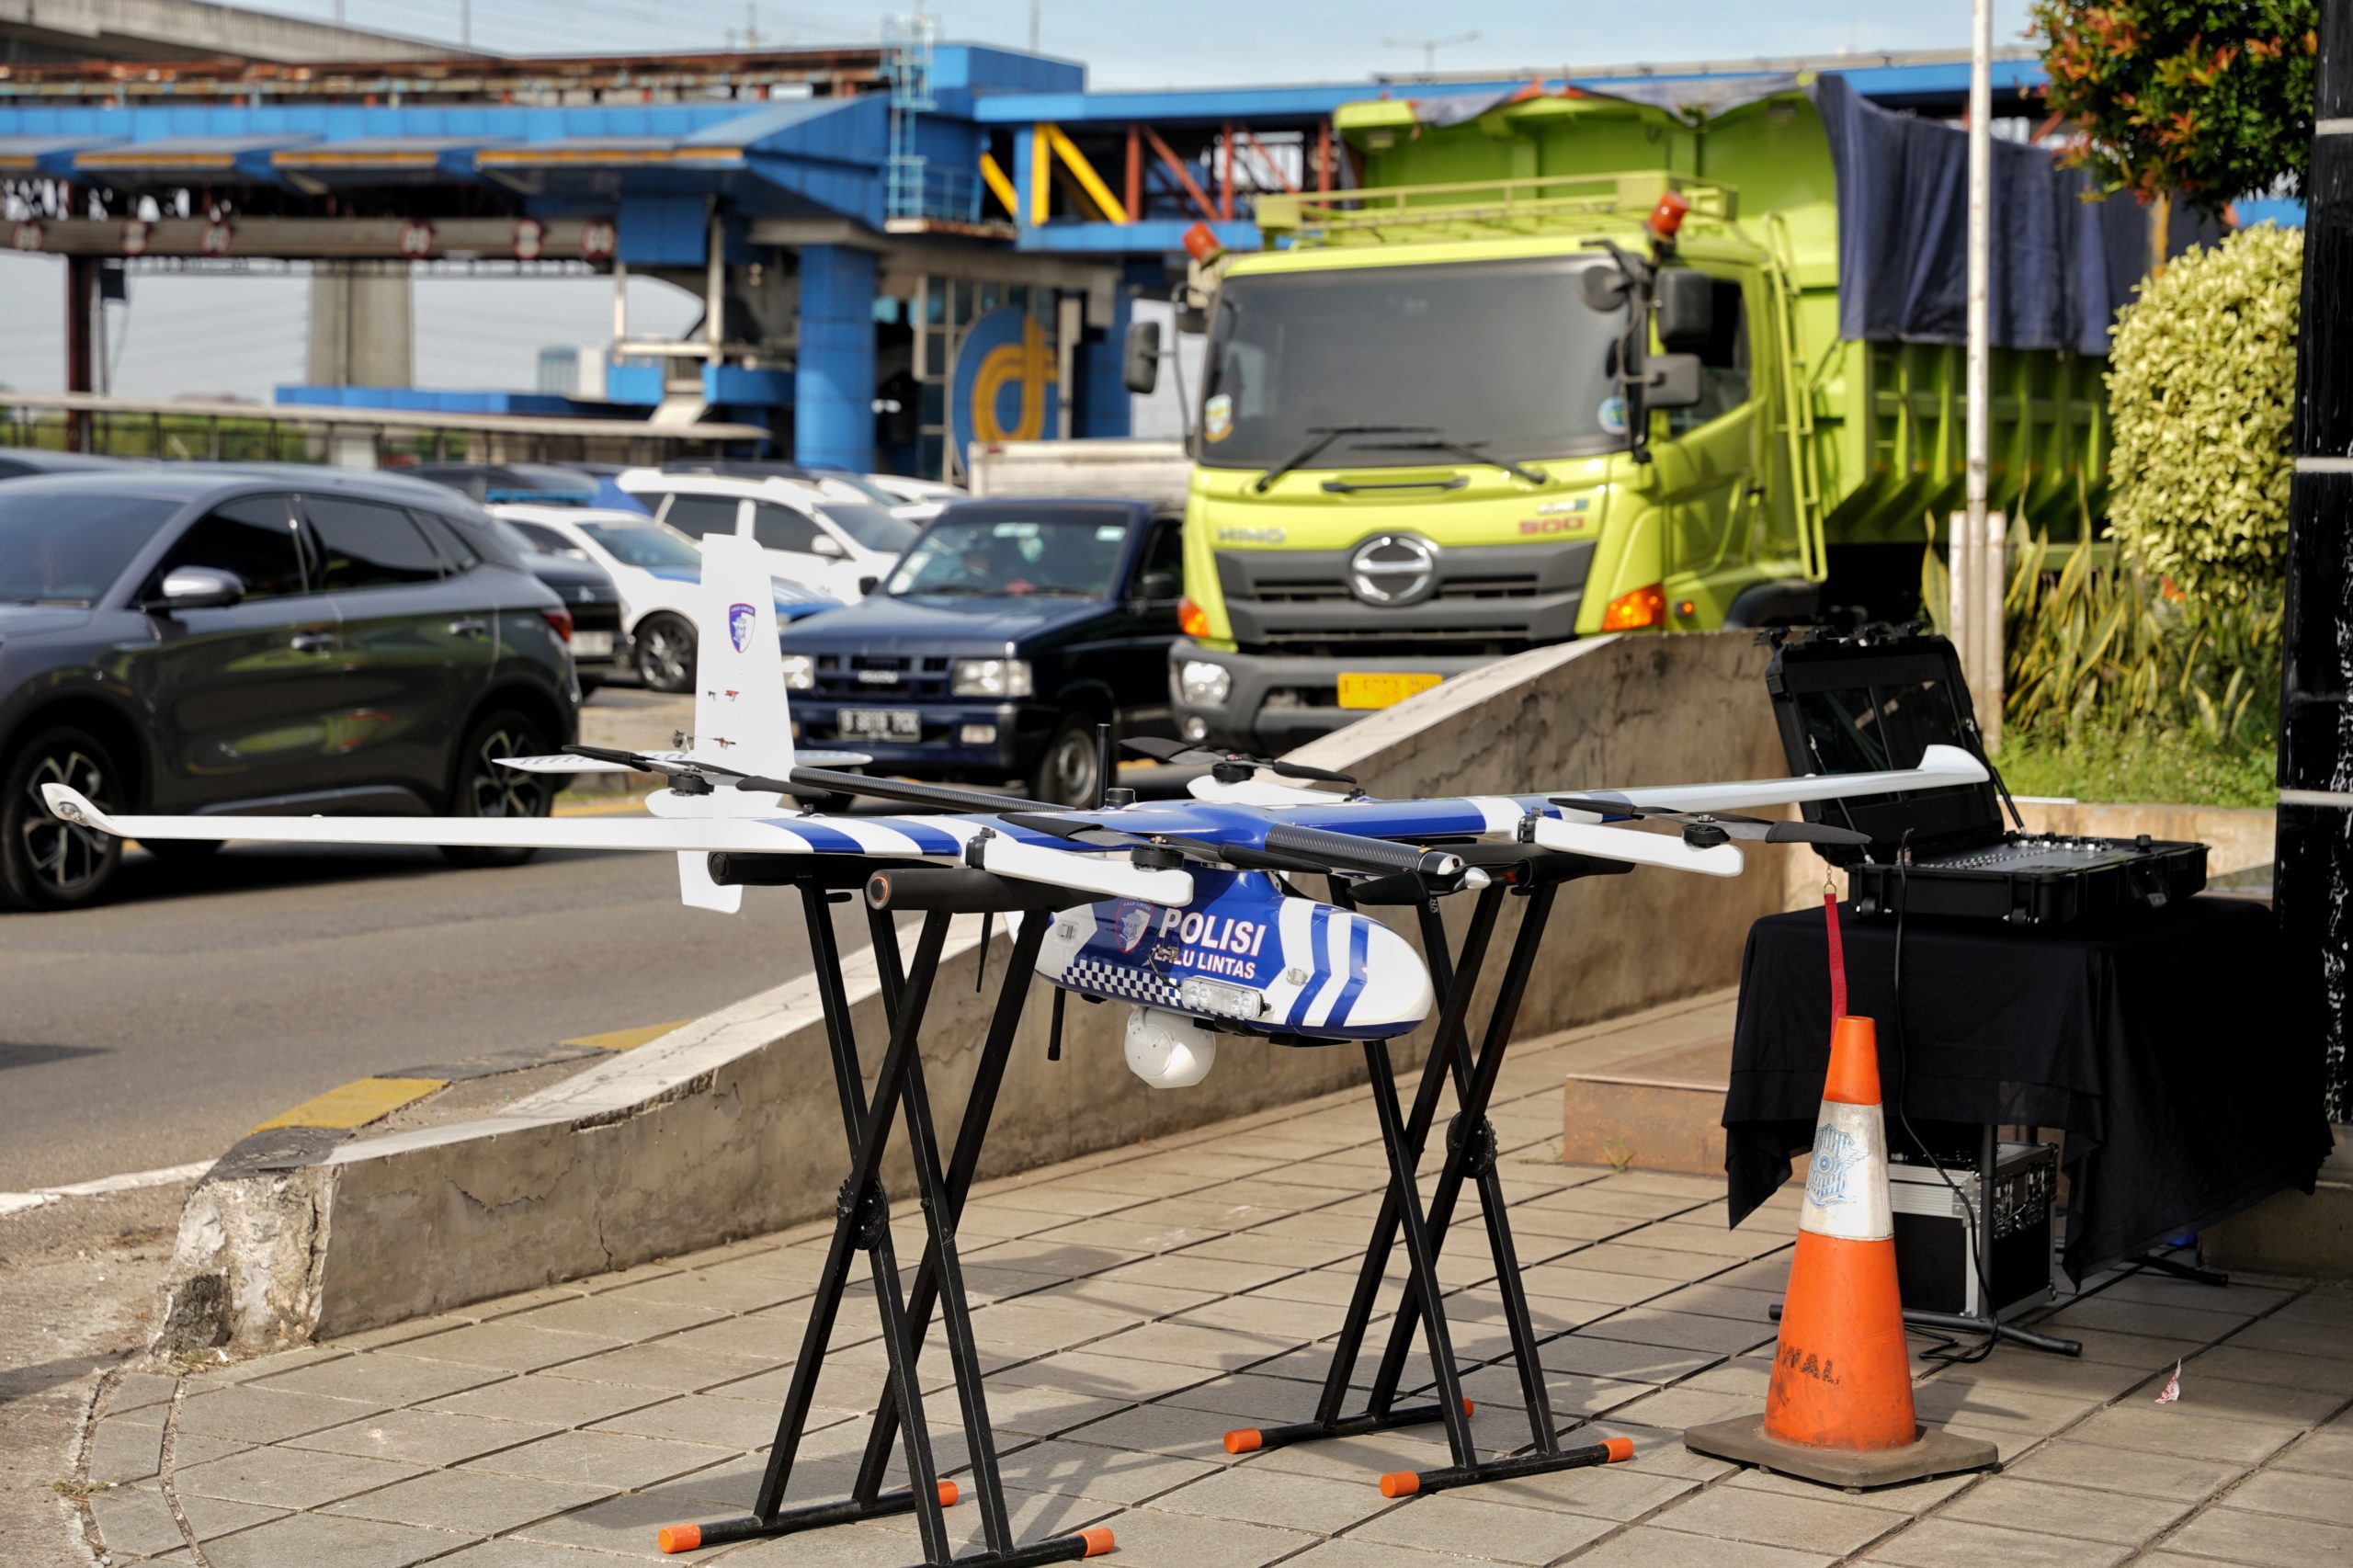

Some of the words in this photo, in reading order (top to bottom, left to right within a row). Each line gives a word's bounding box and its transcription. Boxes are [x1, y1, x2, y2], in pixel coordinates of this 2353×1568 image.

[1518, 516, 1585, 536] 500
[1158, 907, 1267, 957] POLISI
[1197, 952, 1256, 980] LINTAS
